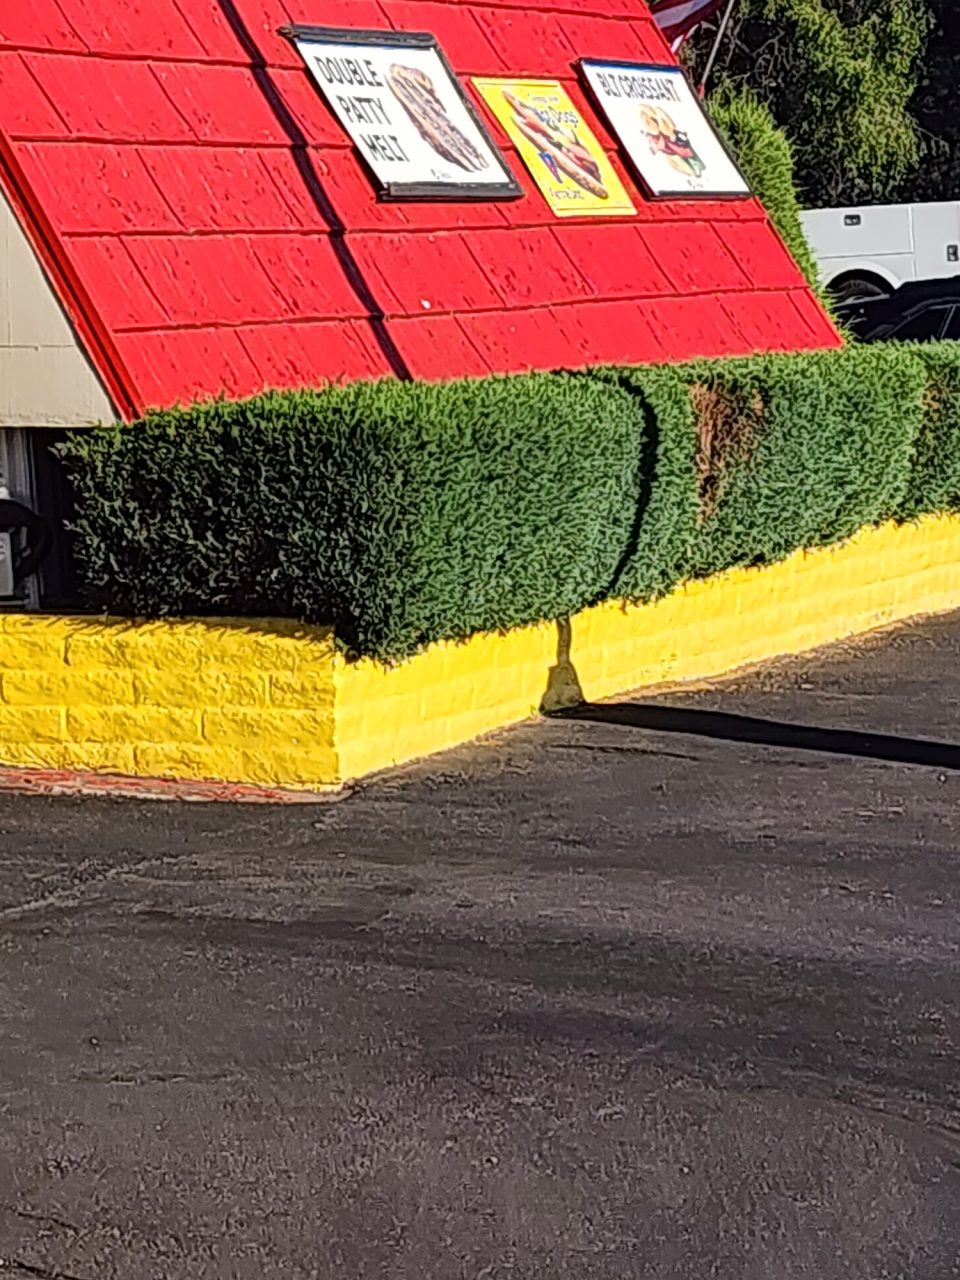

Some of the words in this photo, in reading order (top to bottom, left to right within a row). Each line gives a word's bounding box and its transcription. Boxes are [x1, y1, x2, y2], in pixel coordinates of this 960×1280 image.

[314, 56, 384, 87] DOUBLE
[597, 73, 621, 97] BLT
[618, 74, 681, 102] CROISSANT
[336, 95, 392, 125] PATTY
[359, 133, 410, 162] MELT
